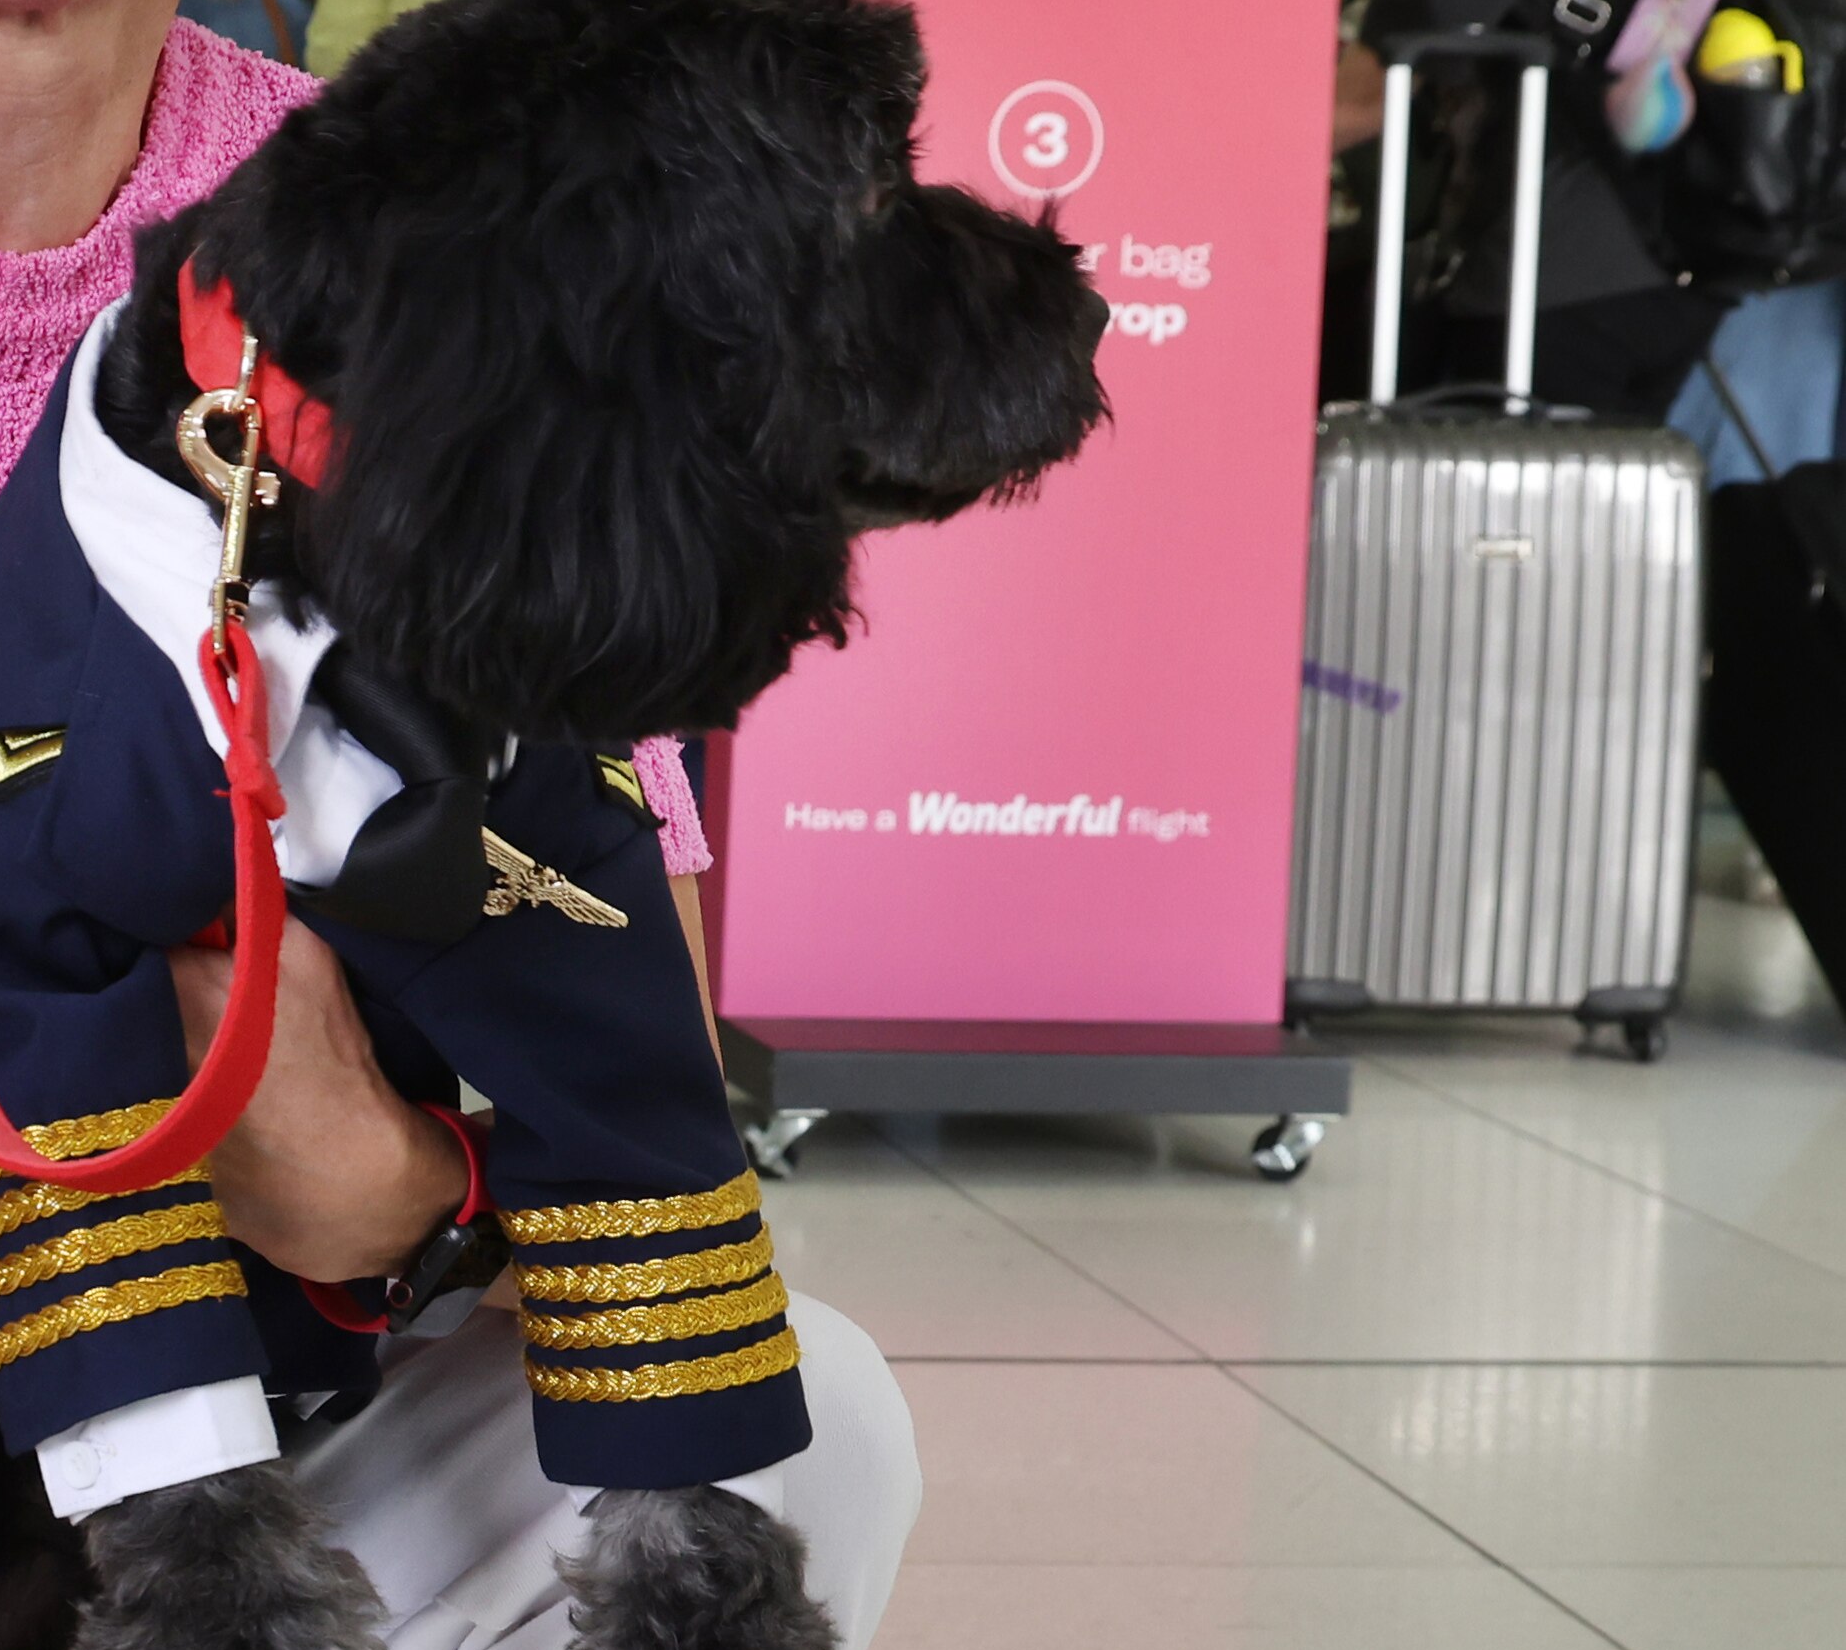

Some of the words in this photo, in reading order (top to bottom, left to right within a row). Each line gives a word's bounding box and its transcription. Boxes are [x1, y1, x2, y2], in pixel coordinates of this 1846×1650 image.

[1022, 112, 1069, 168] 3
[1120, 232, 1213, 289] bag
[1105, 302, 1188, 345] rop
[784, 801, 868, 831] Have
[873, 807, 897, 832] a
[908, 791, 1123, 837] Wonderful
[1127, 805, 1210, 842] flight
